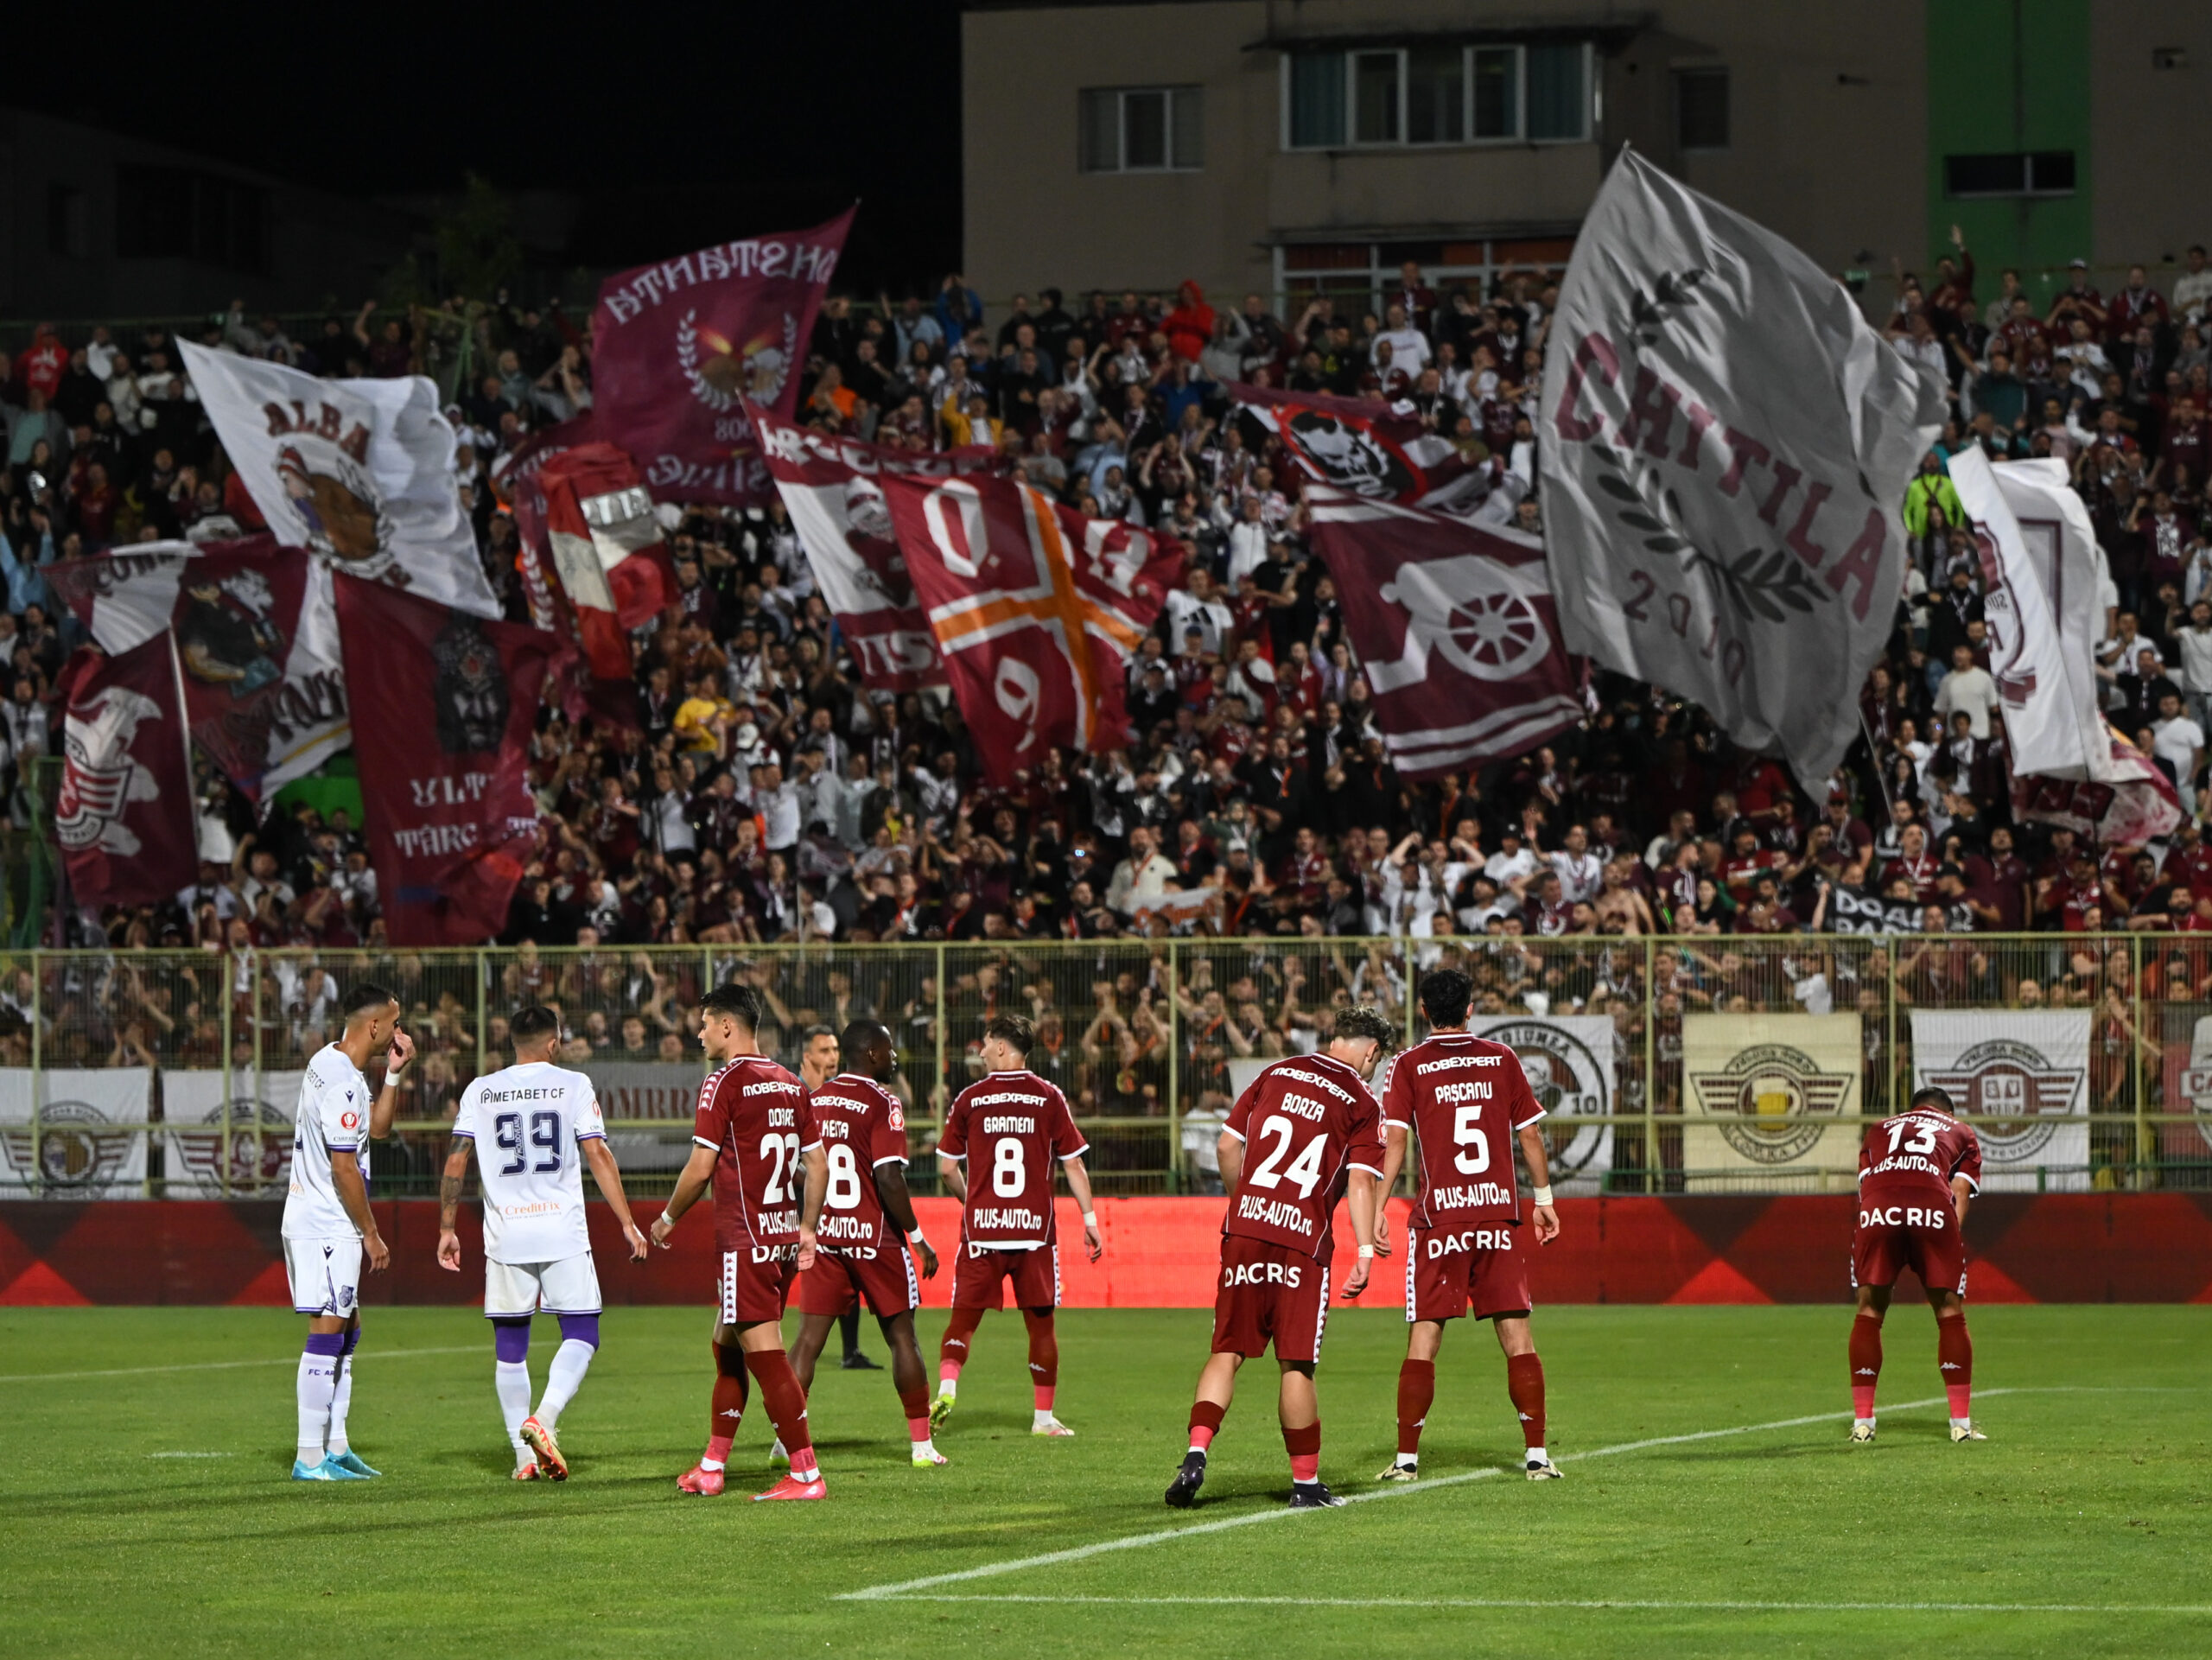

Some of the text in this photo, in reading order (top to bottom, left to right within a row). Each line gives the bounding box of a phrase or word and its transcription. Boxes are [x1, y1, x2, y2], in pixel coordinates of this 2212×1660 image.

[263, 399, 372, 466] ALBA
[1556, 332, 1887, 622] CHITILA
[1624, 570, 1746, 688] 2010
[1417, 1056, 1503, 1075] MOBEXPERT
[493, 1088, 565, 1103] METABET CF
[743, 1082, 801, 1097] MOBEXPERT
[1270, 1067, 1357, 1104] MOBEXPERT
[1435, 1082, 1492, 1107] PAȘCANU
[970, 1092, 1047, 1109] MOBEXPERT
[1281, 1092, 1325, 1123] BORZA
[822, 1119, 849, 1140] KEITA
[983, 1116, 1034, 1134] GRAMENI
[1884, 1115, 1952, 1133] CIOBOTARIU
[494, 1110, 564, 1178] 99
[1453, 1105, 1490, 1175] 5
[1887, 1123, 1942, 1154] 13
[993, 1137, 1026, 1198] 8
[1249, 1115, 1329, 1200] 24
[823, 1143, 861, 1210] 8
[505, 1202, 561, 1216] CreditFix
[1433, 1182, 1510, 1211] PLUS-AUTO.ro
[817, 1213, 873, 1239] S-AUTO.ro
[974, 1208, 1042, 1230] PLUS-AUTO.ro
[1237, 1195, 1313, 1237] PLUS-AUTO.ro
[1859, 1206, 1945, 1230] DACRIS
[752, 1245, 798, 1263] DACR
[1427, 1230, 1512, 1259] DACRIS
[1224, 1262, 1302, 1288] DACRIS
